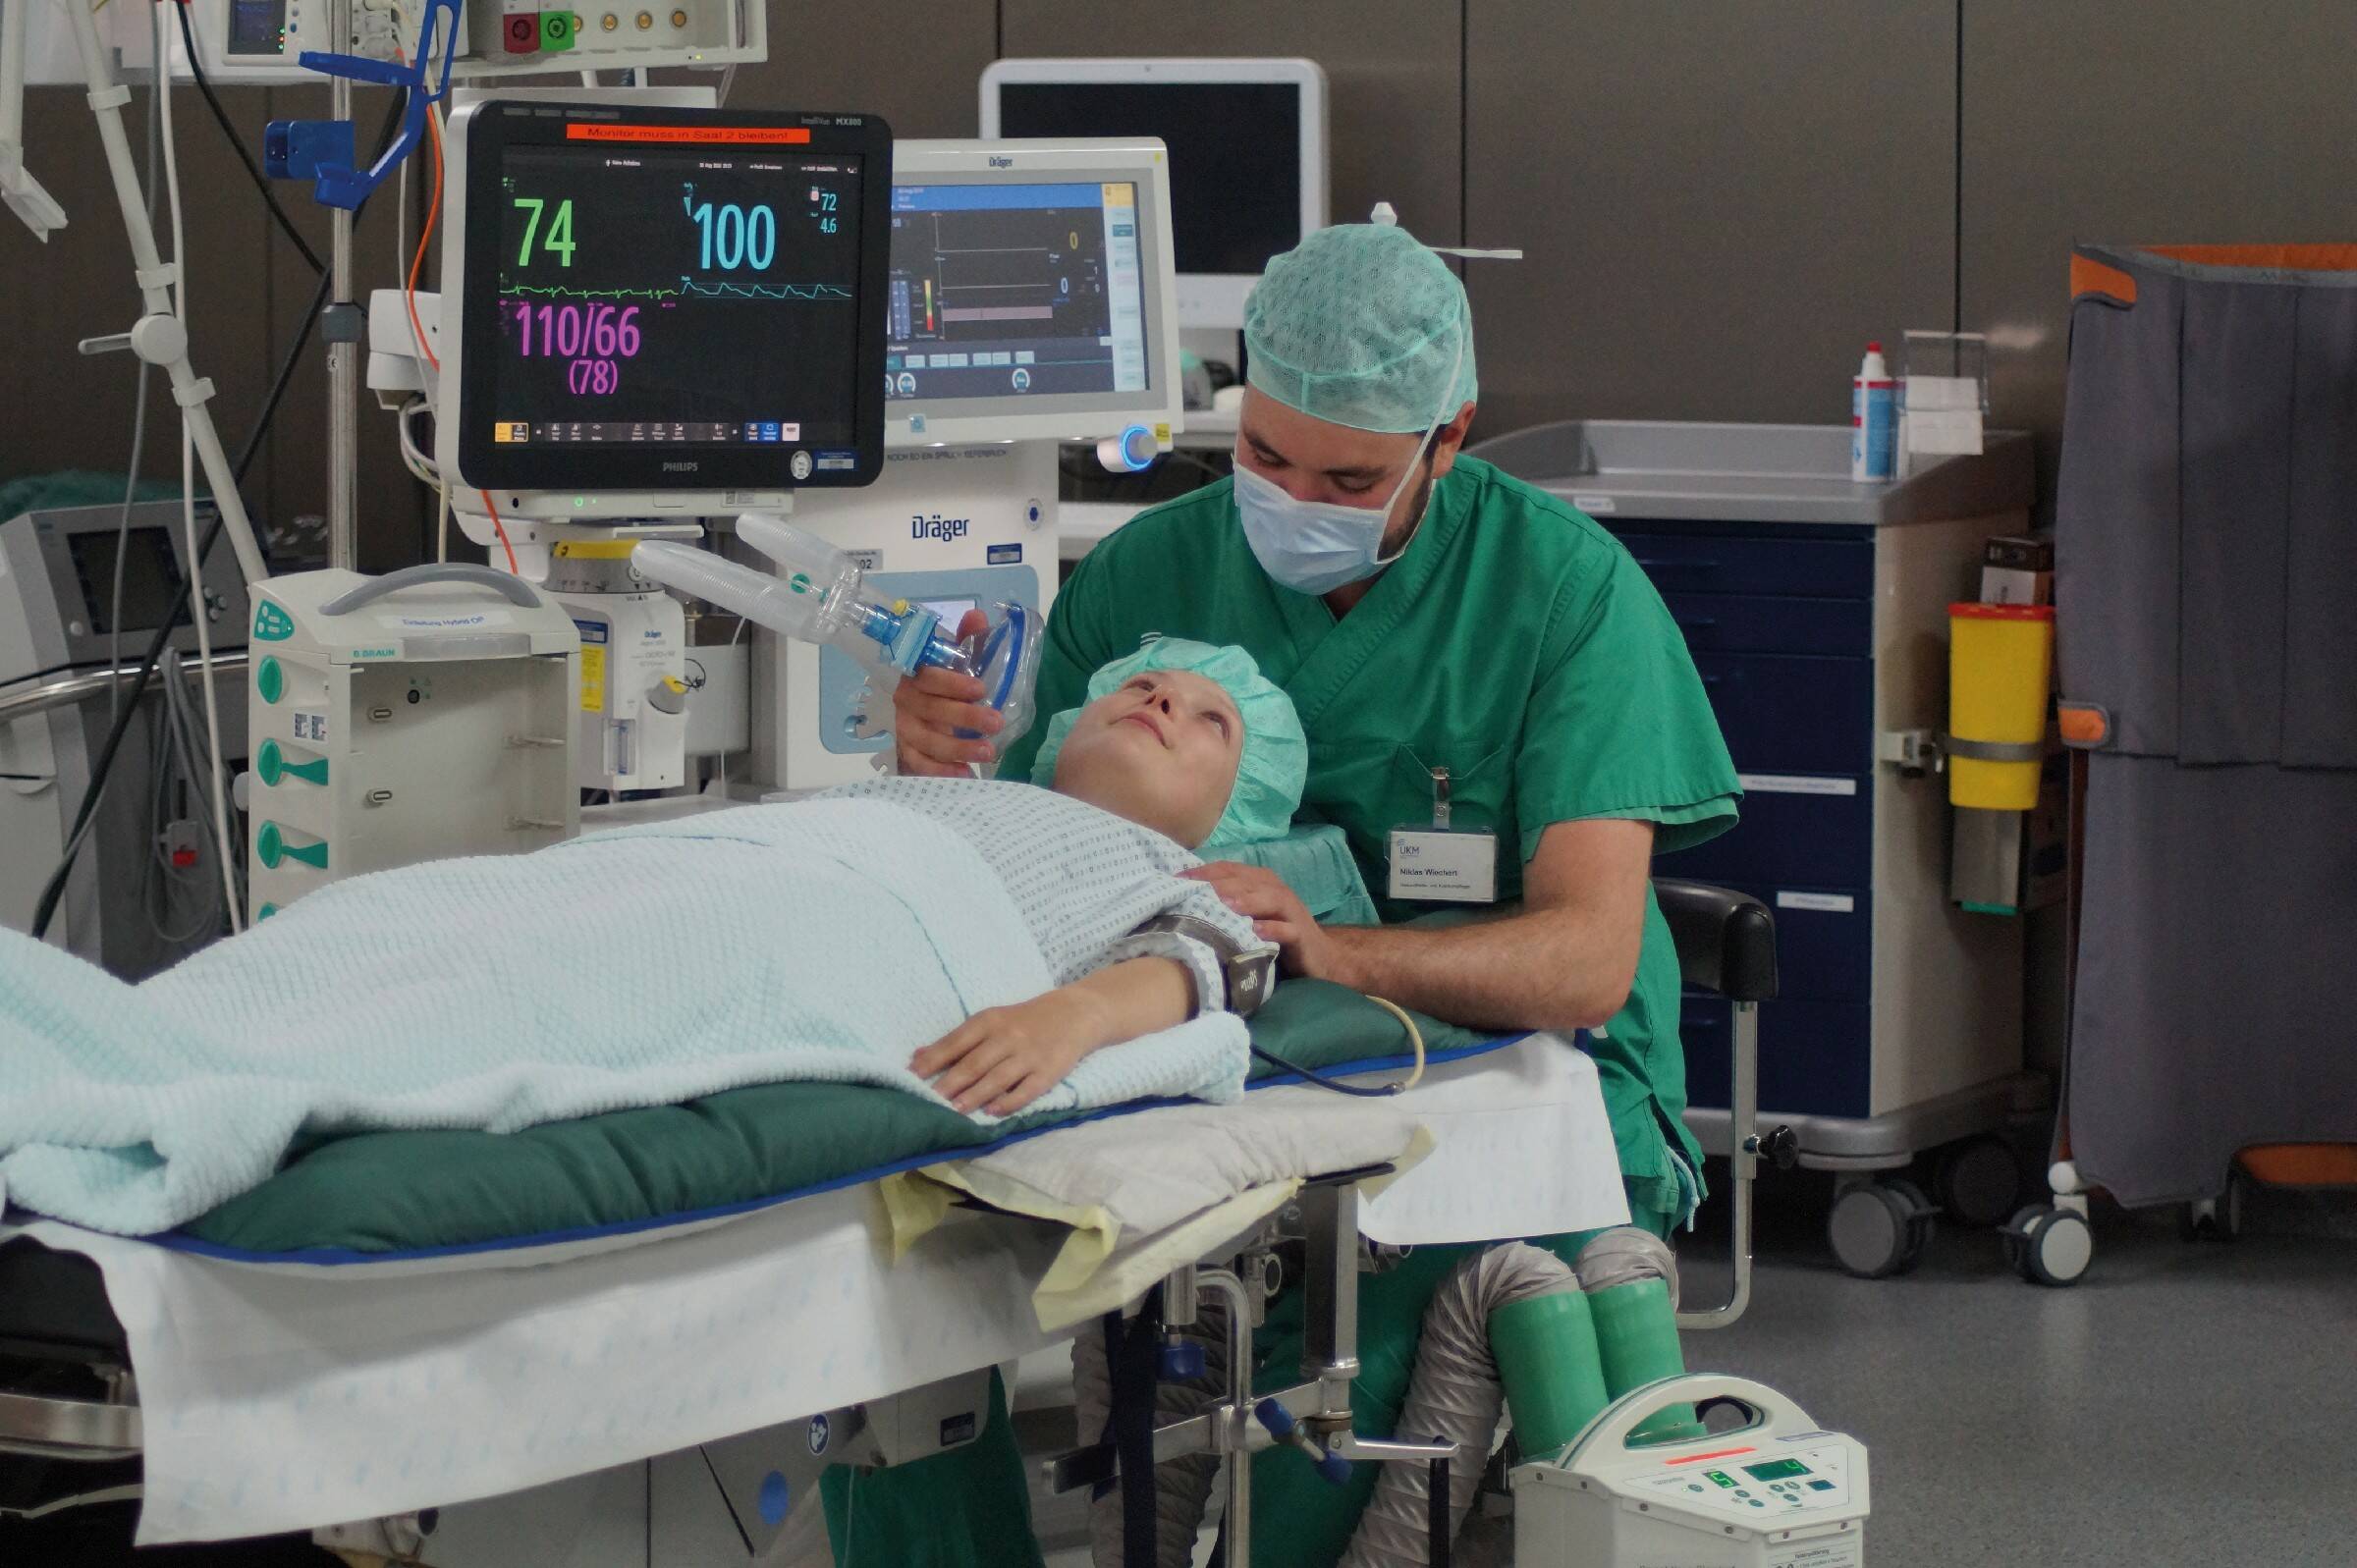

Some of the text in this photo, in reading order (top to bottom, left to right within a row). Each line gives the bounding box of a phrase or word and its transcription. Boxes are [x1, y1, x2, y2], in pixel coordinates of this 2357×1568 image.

[587, 127, 634, 137] Monitor
[638, 130, 674, 138] muss
[693, 130, 723, 139] Saal
[727, 131, 735, 139] 2
[821, 193, 837, 211] 72
[514, 198, 576, 267] 74
[820, 217, 837, 234] 4.6
[693, 202, 775, 270] 100
[1069, 231, 1078, 249] 0
[1060, 277, 1069, 294] 0
[516, 305, 640, 356] 110/66
[569, 359, 618, 395] (78)
[663, 461, 698, 472] PHILIPS
[911, 514, 969, 542] Dräger
[1399, 845, 1420, 855] UKM
[1783, 1460, 1807, 1474] 4
